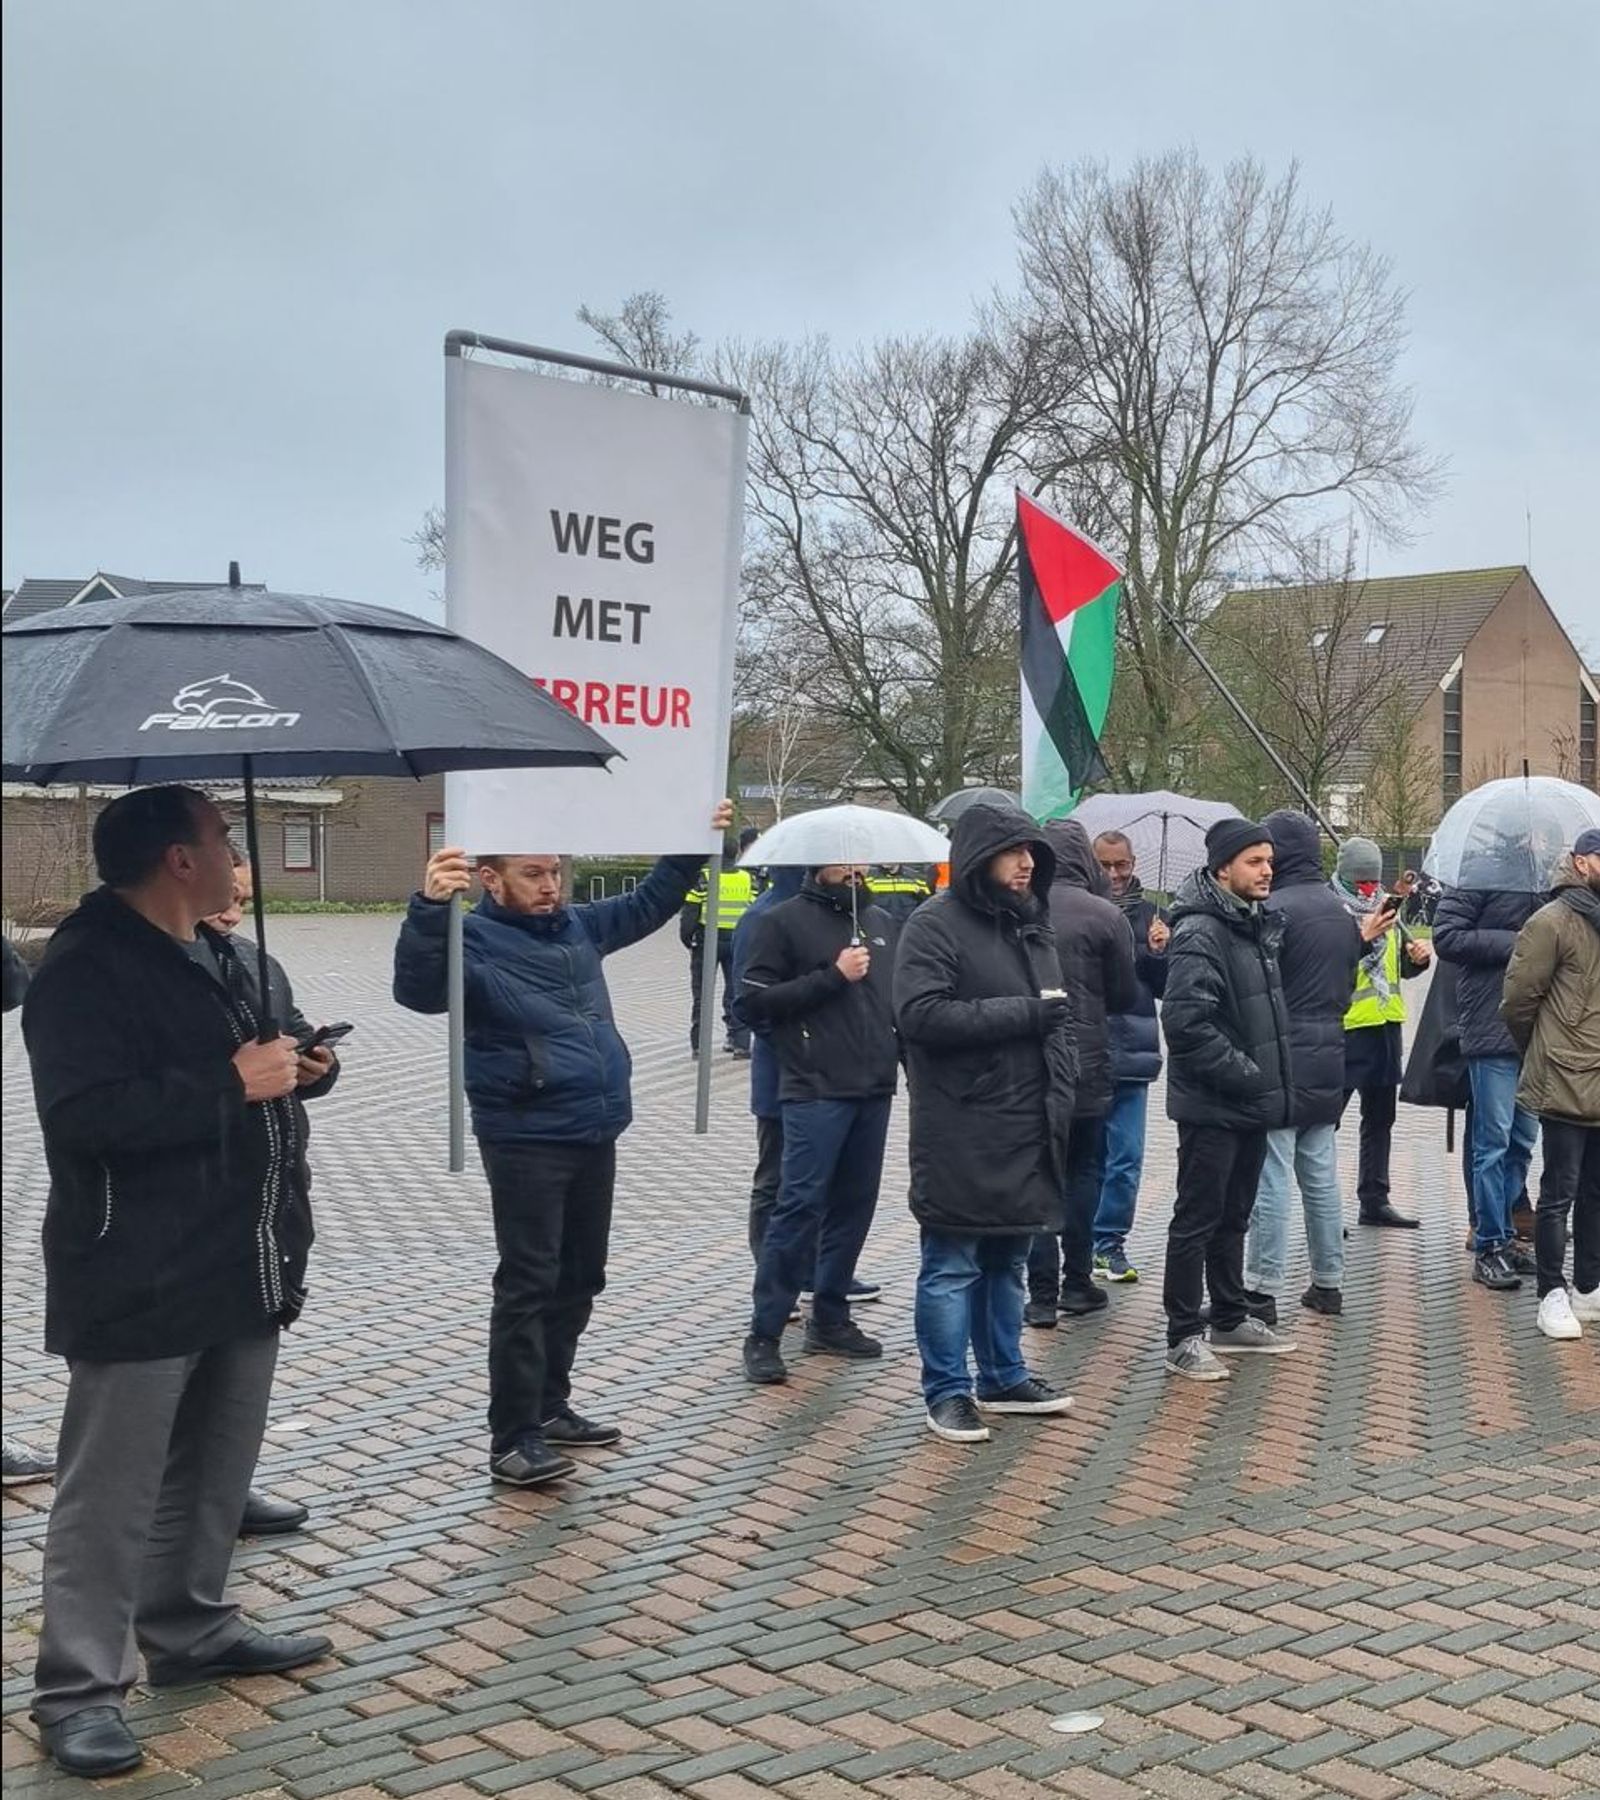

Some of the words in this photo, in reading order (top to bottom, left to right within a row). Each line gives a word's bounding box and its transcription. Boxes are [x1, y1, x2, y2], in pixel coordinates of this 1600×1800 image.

[550, 509, 654, 564] WEG
[553, 595, 651, 644] MET
[138, 711, 301, 731] Falcon
[533, 678, 692, 728] RREUR
